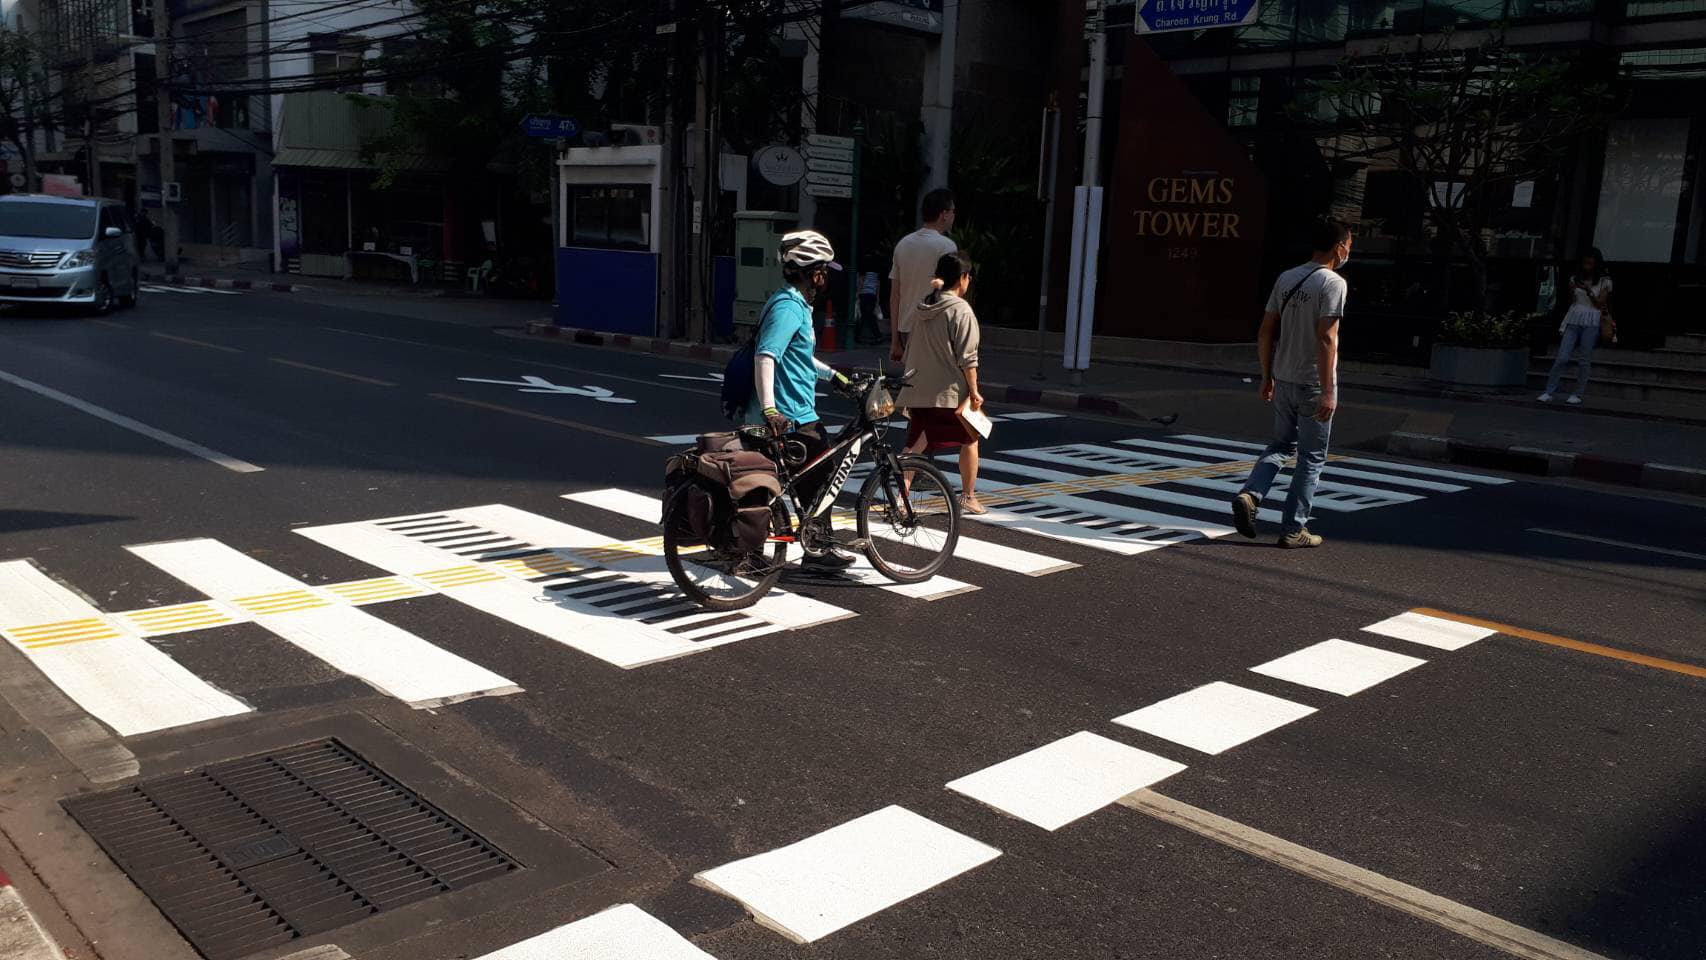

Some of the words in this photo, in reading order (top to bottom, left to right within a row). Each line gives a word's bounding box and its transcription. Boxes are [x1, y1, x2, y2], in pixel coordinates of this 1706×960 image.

[1155, 18, 1189, 28] Charoen
[1194, 15, 1219, 24] Krung
[1148, 177, 1234, 204] GEMS
[1133, 210, 1240, 238] TOWER
[827, 451, 857, 497] TRINX
